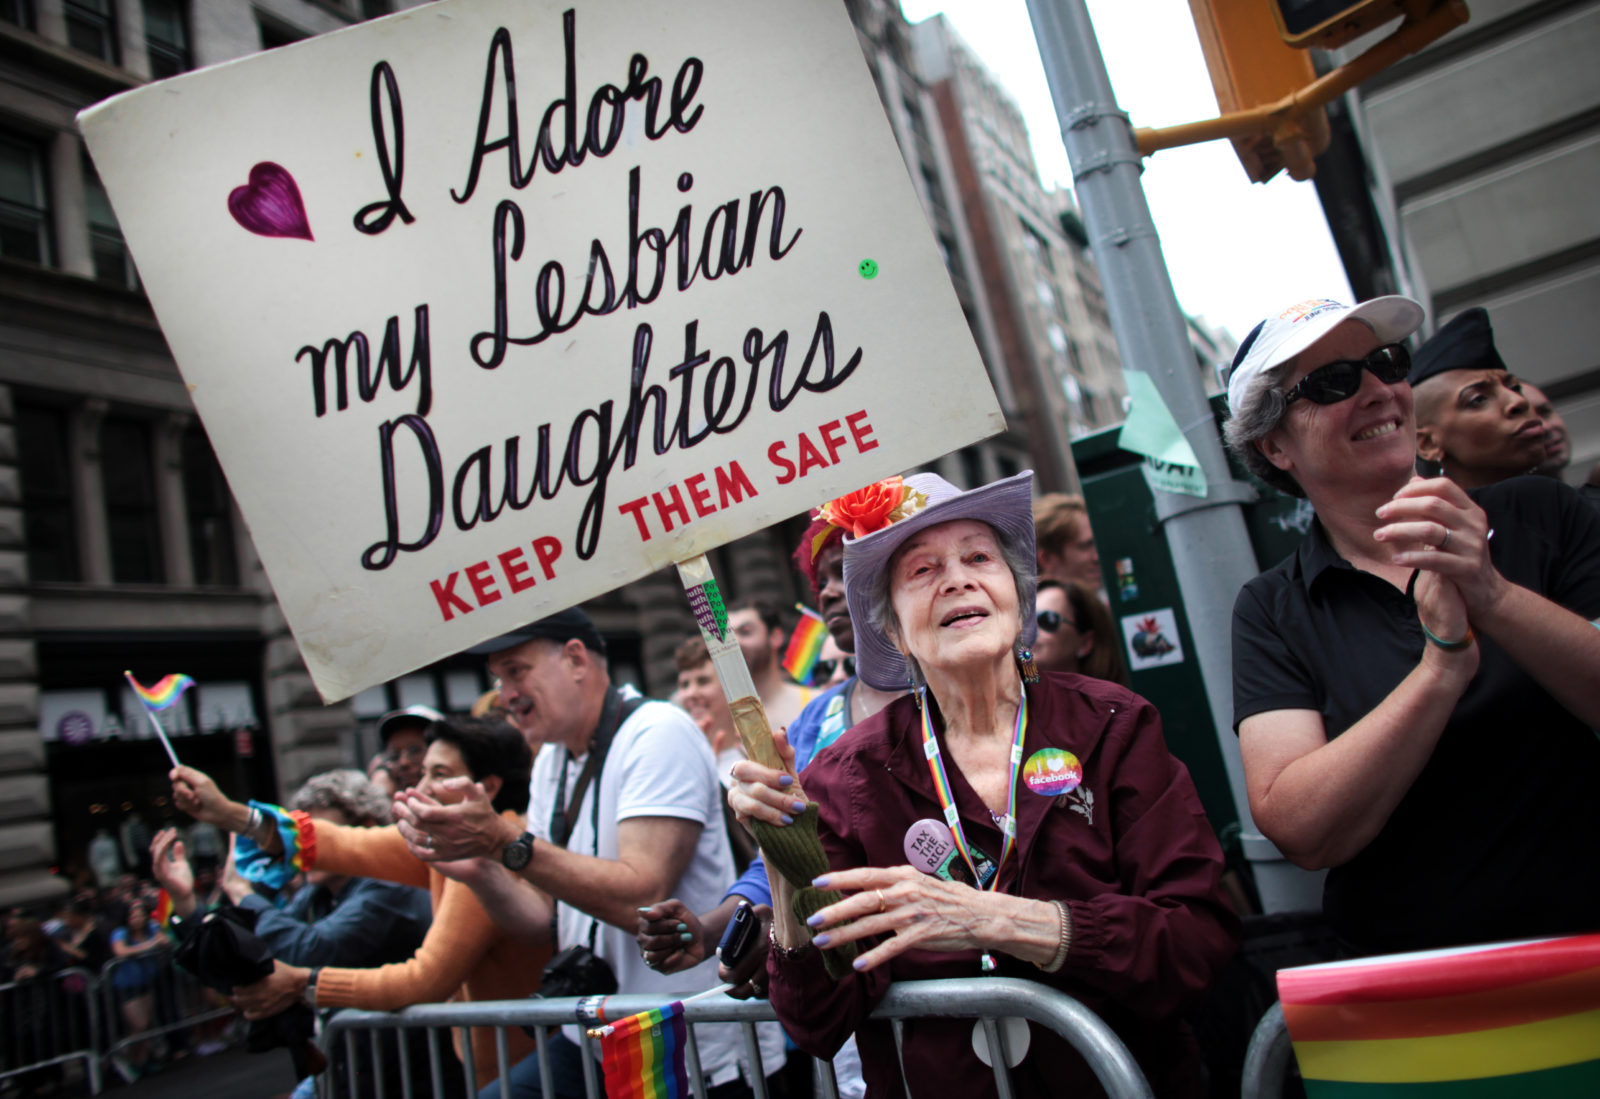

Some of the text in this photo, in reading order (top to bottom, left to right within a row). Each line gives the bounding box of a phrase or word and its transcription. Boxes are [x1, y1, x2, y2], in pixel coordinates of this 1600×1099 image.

[354, 8, 704, 235] I Adore
[294, 166, 803, 417] my Lesbian
[361, 311, 863, 571] Daughters
[430, 410, 879, 621] KEEP THEM SAFE
[1028, 770, 1078, 785] facebook
[910, 830, 930, 851] TAX
[919, 836, 939, 858] THE
[926, 841, 950, 868] RICH
